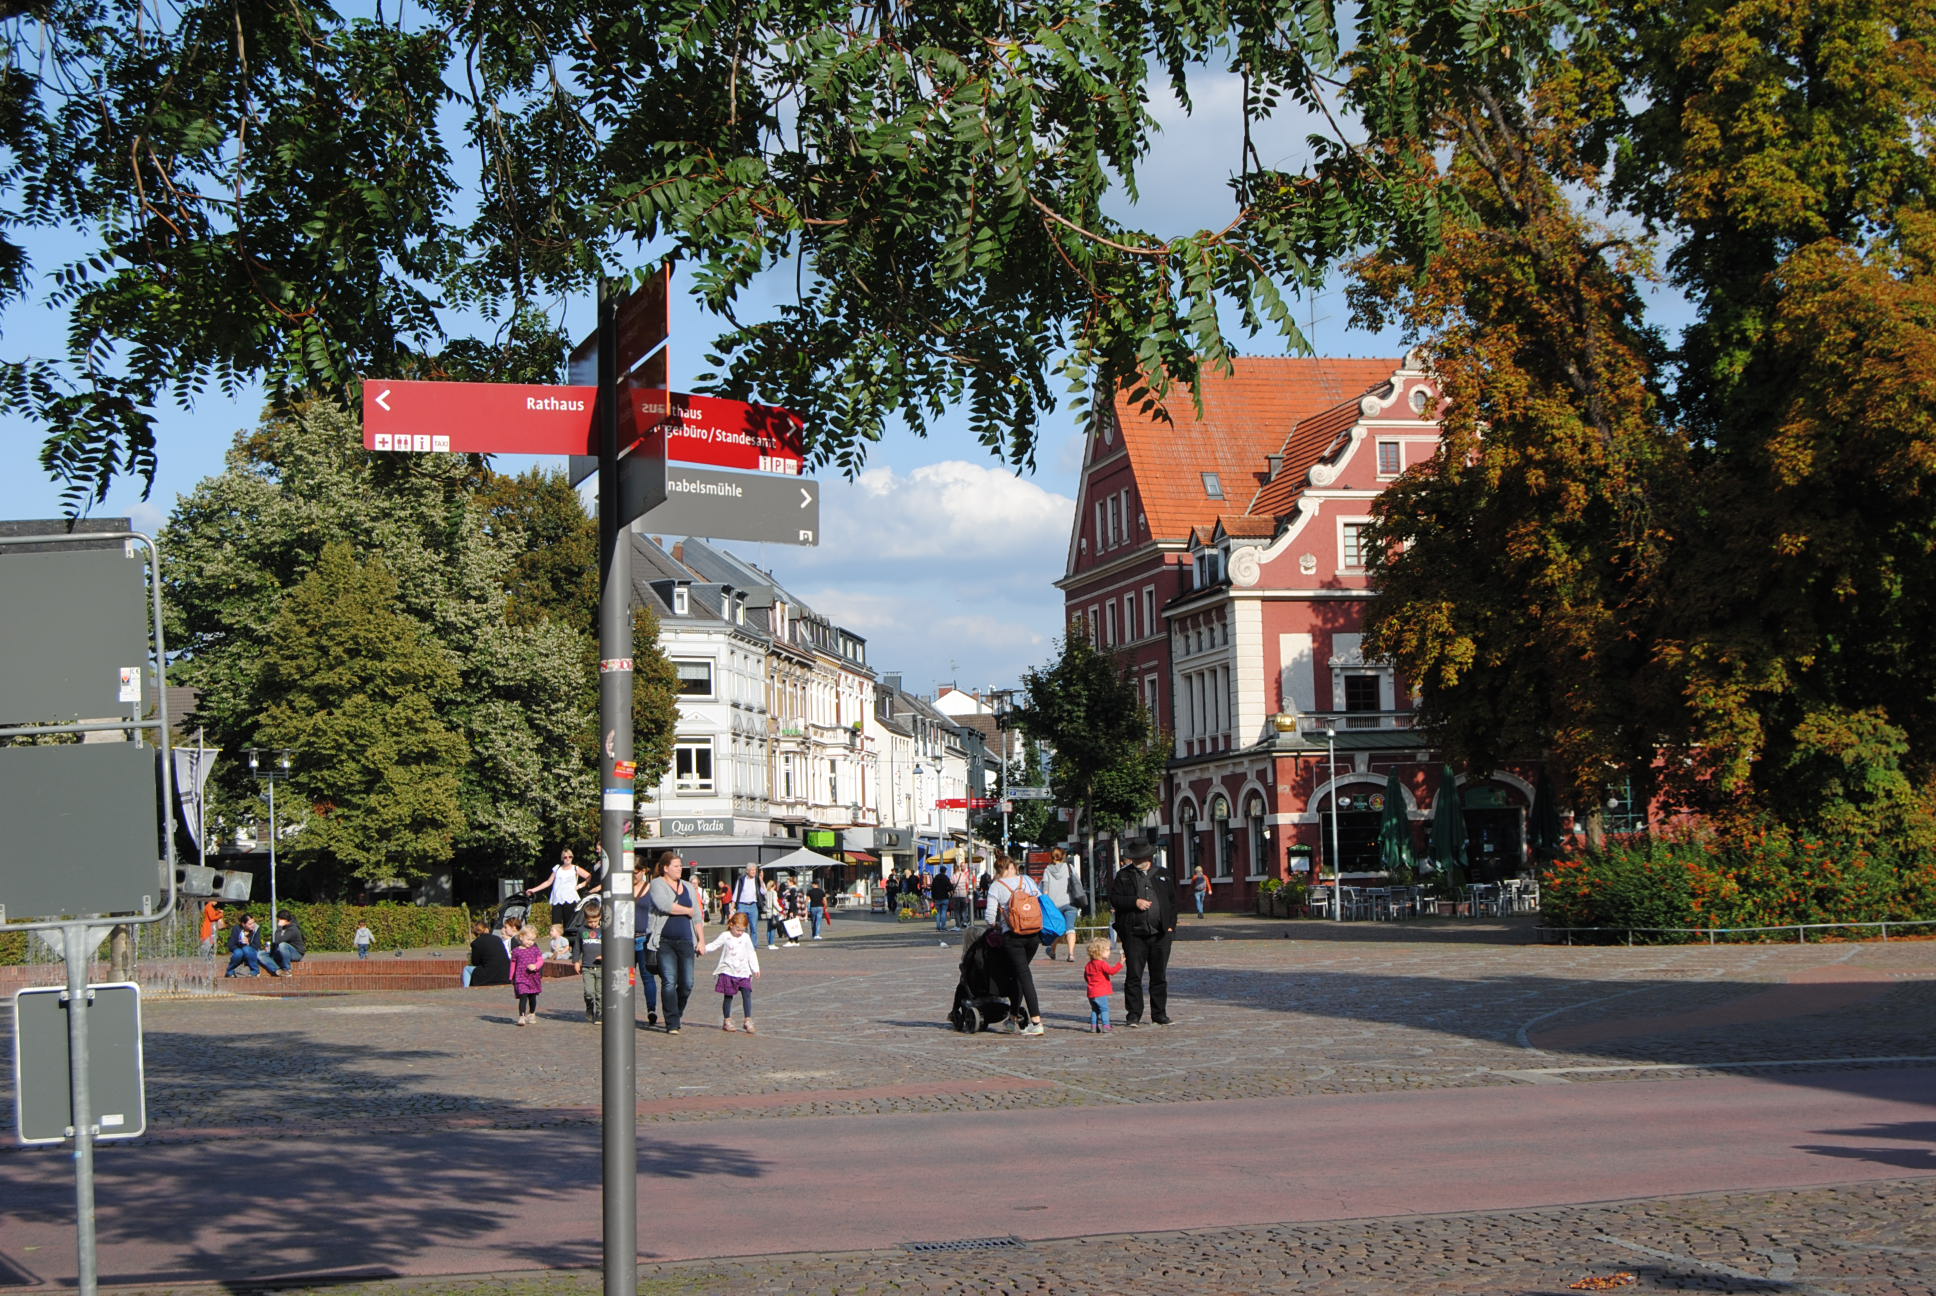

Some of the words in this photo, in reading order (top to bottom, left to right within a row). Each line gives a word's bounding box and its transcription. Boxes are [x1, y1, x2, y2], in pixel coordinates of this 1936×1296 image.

[527, 396, 585, 411] Rathaus
[671, 404, 703, 420] thaus
[668, 478, 743, 498] nabelsmühle
[671, 820, 695, 835] Quo
[696, 819, 724, 832] Vadis
